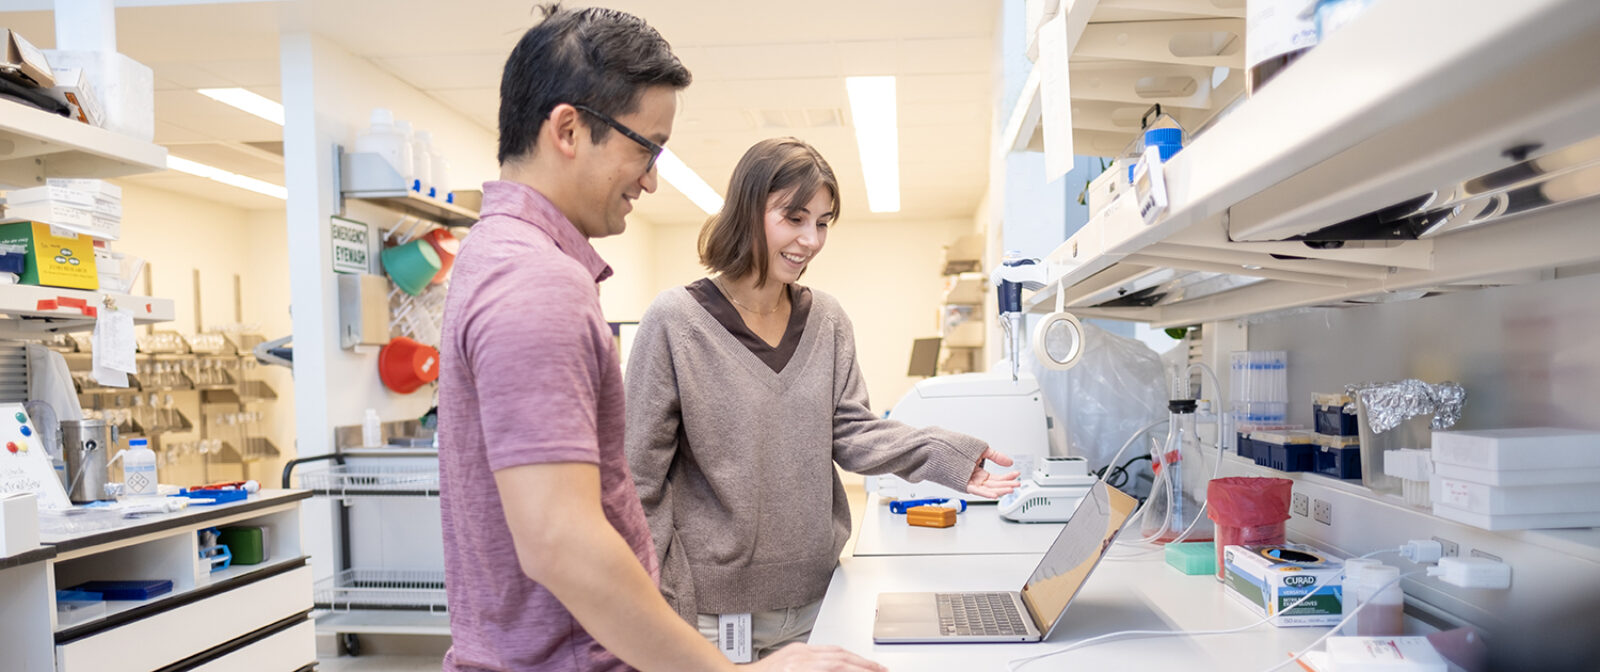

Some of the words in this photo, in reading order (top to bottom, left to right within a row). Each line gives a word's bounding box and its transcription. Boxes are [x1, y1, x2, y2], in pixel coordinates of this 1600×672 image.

[332, 223, 367, 244] EMERGENCY
[336, 245, 366, 264] EYEWASH
[1285, 576, 1315, 585] CURAD
